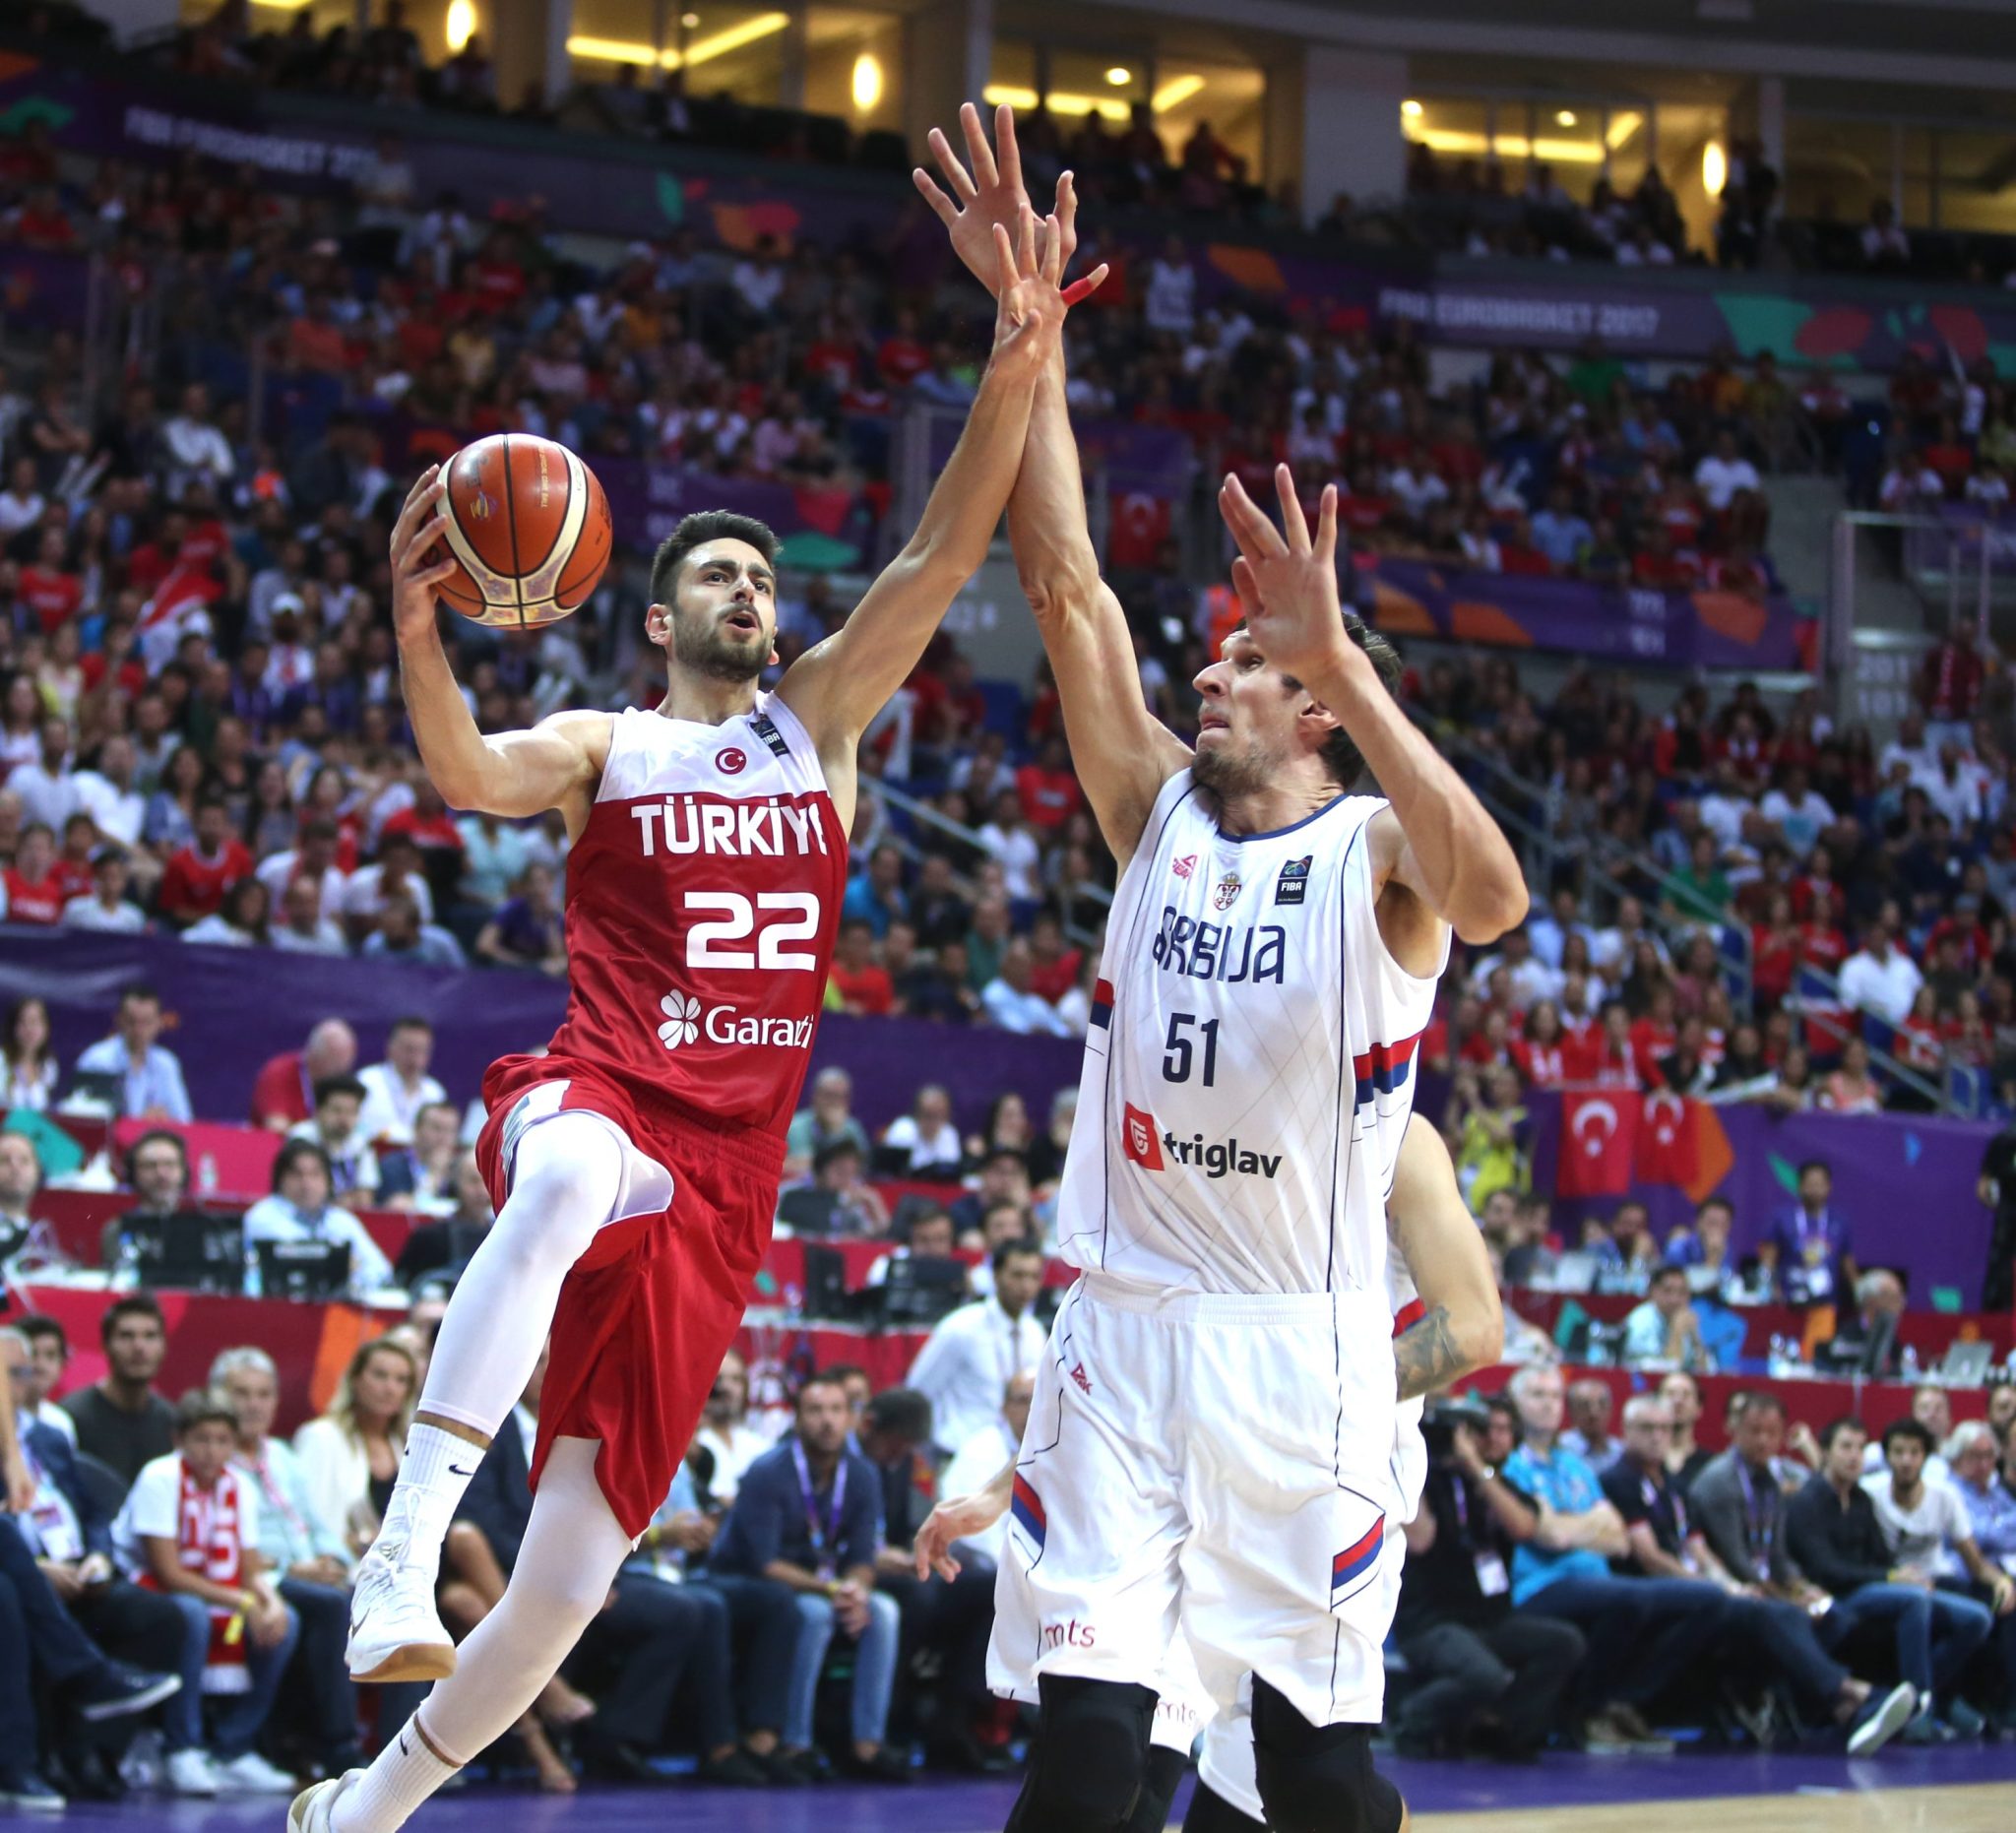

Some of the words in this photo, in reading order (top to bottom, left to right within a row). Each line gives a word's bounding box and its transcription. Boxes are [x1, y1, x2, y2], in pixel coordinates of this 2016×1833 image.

[762, 732, 781, 745] IBA
[1281, 882, 1302, 892] FIBA
[684, 892, 820, 972] 22
[1163, 1012, 1220, 1088] 51
[1164, 1132, 1283, 1178] triglav
[1045, 1618, 1096, 1649] mts
